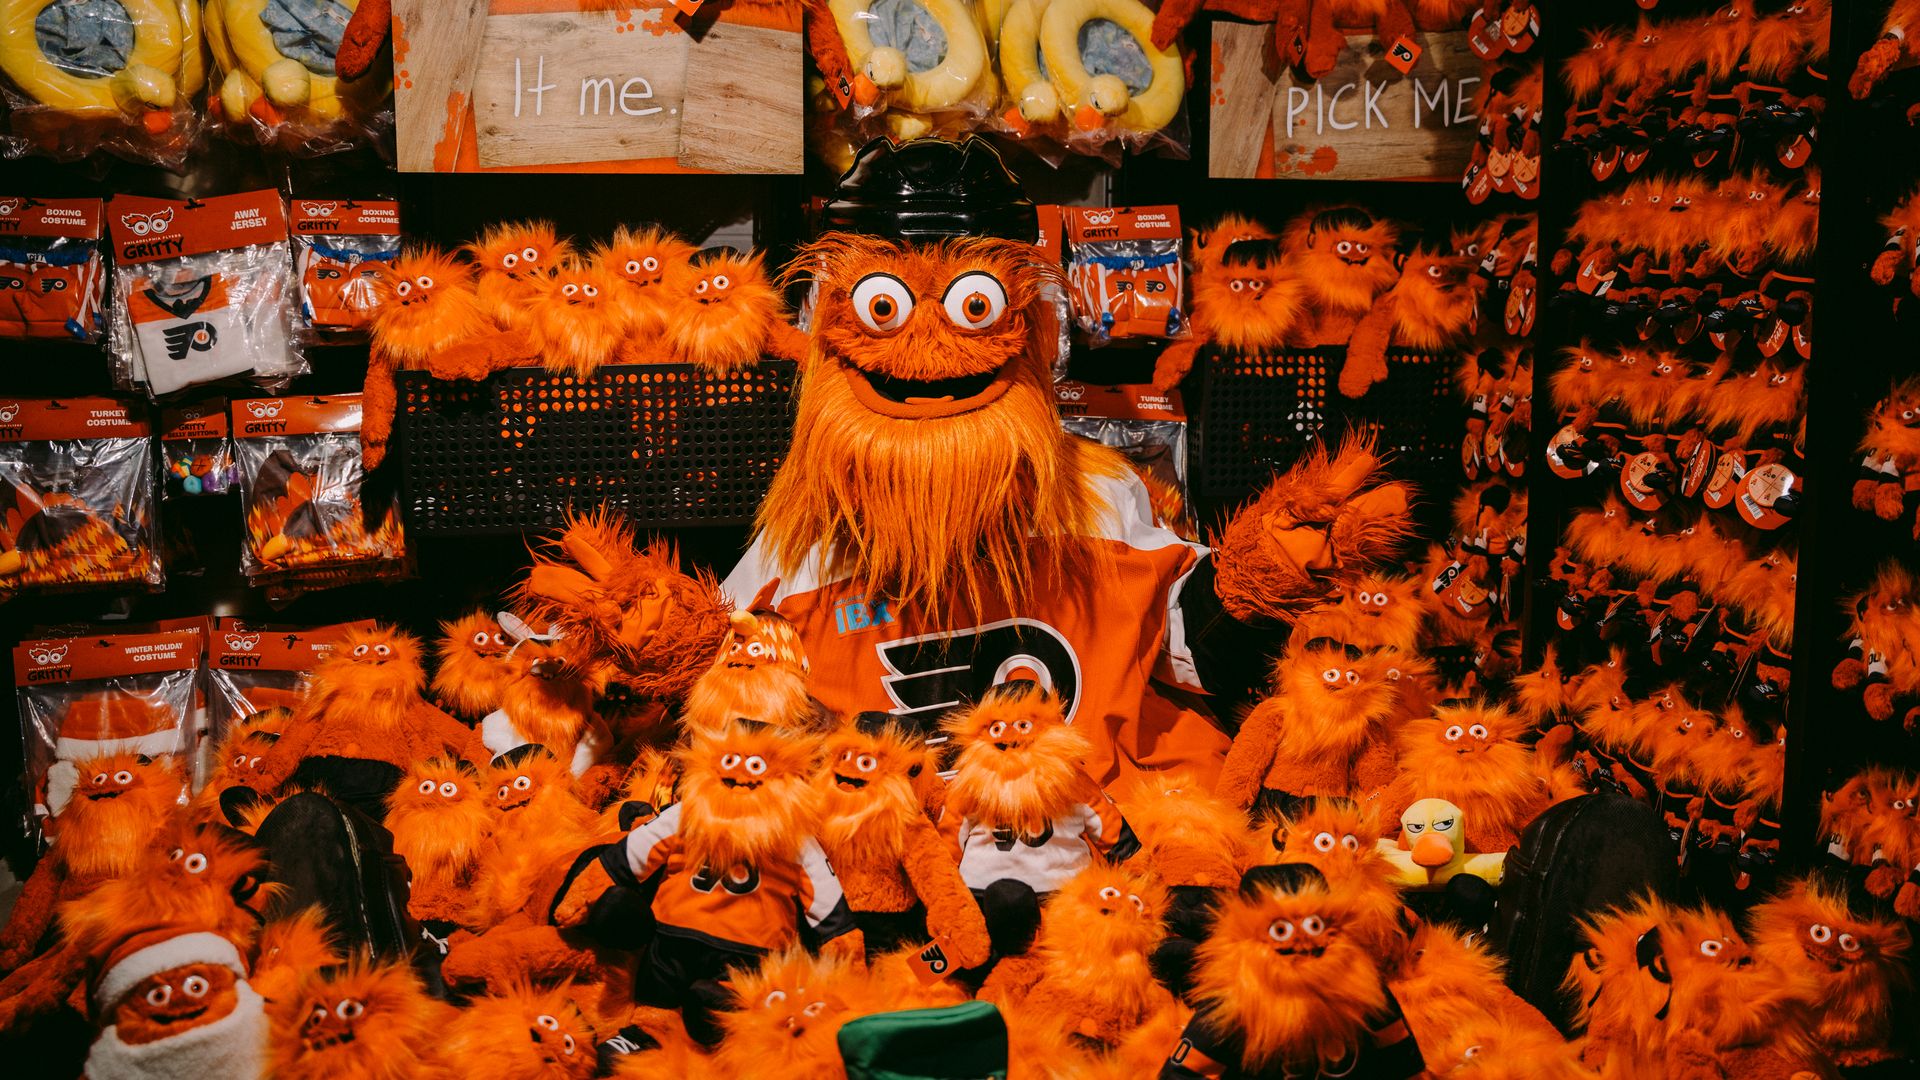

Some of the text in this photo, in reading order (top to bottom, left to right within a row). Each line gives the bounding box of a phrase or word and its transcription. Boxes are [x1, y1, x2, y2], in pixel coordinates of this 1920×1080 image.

[514, 55, 676, 117] It me.
[1286, 77, 1481, 139] PICK ME
[46, 208, 82, 217] BOXING
[234, 208, 260, 220] AWAY
[362, 209, 395, 217] BOXING
[1137, 213, 1166, 221] BOXING
[41, 216, 87, 226] COSTUME
[230, 217, 267, 231] JERSEY
[297, 220, 340, 231] GRITTY
[357, 216, 399, 224] COSTUME
[1134, 221, 1171, 229] COSTUME
[1082, 227, 1120, 239] GRITTY
[123, 236, 184, 259] GRITTY
[1140, 395, 1169, 403] TURKEY
[1137, 402, 1174, 411] COSTUME
[90, 410, 127, 418] TURKEY
[178, 422, 207, 431] GRITTY
[244, 421, 288, 434] GRITTY
[125, 642, 184, 655] WINTER HOLIDAY
[133, 651, 177, 662] COSTUME
[219, 655, 262, 667] GRITTY
[26, 666, 74, 682] GRITTY
